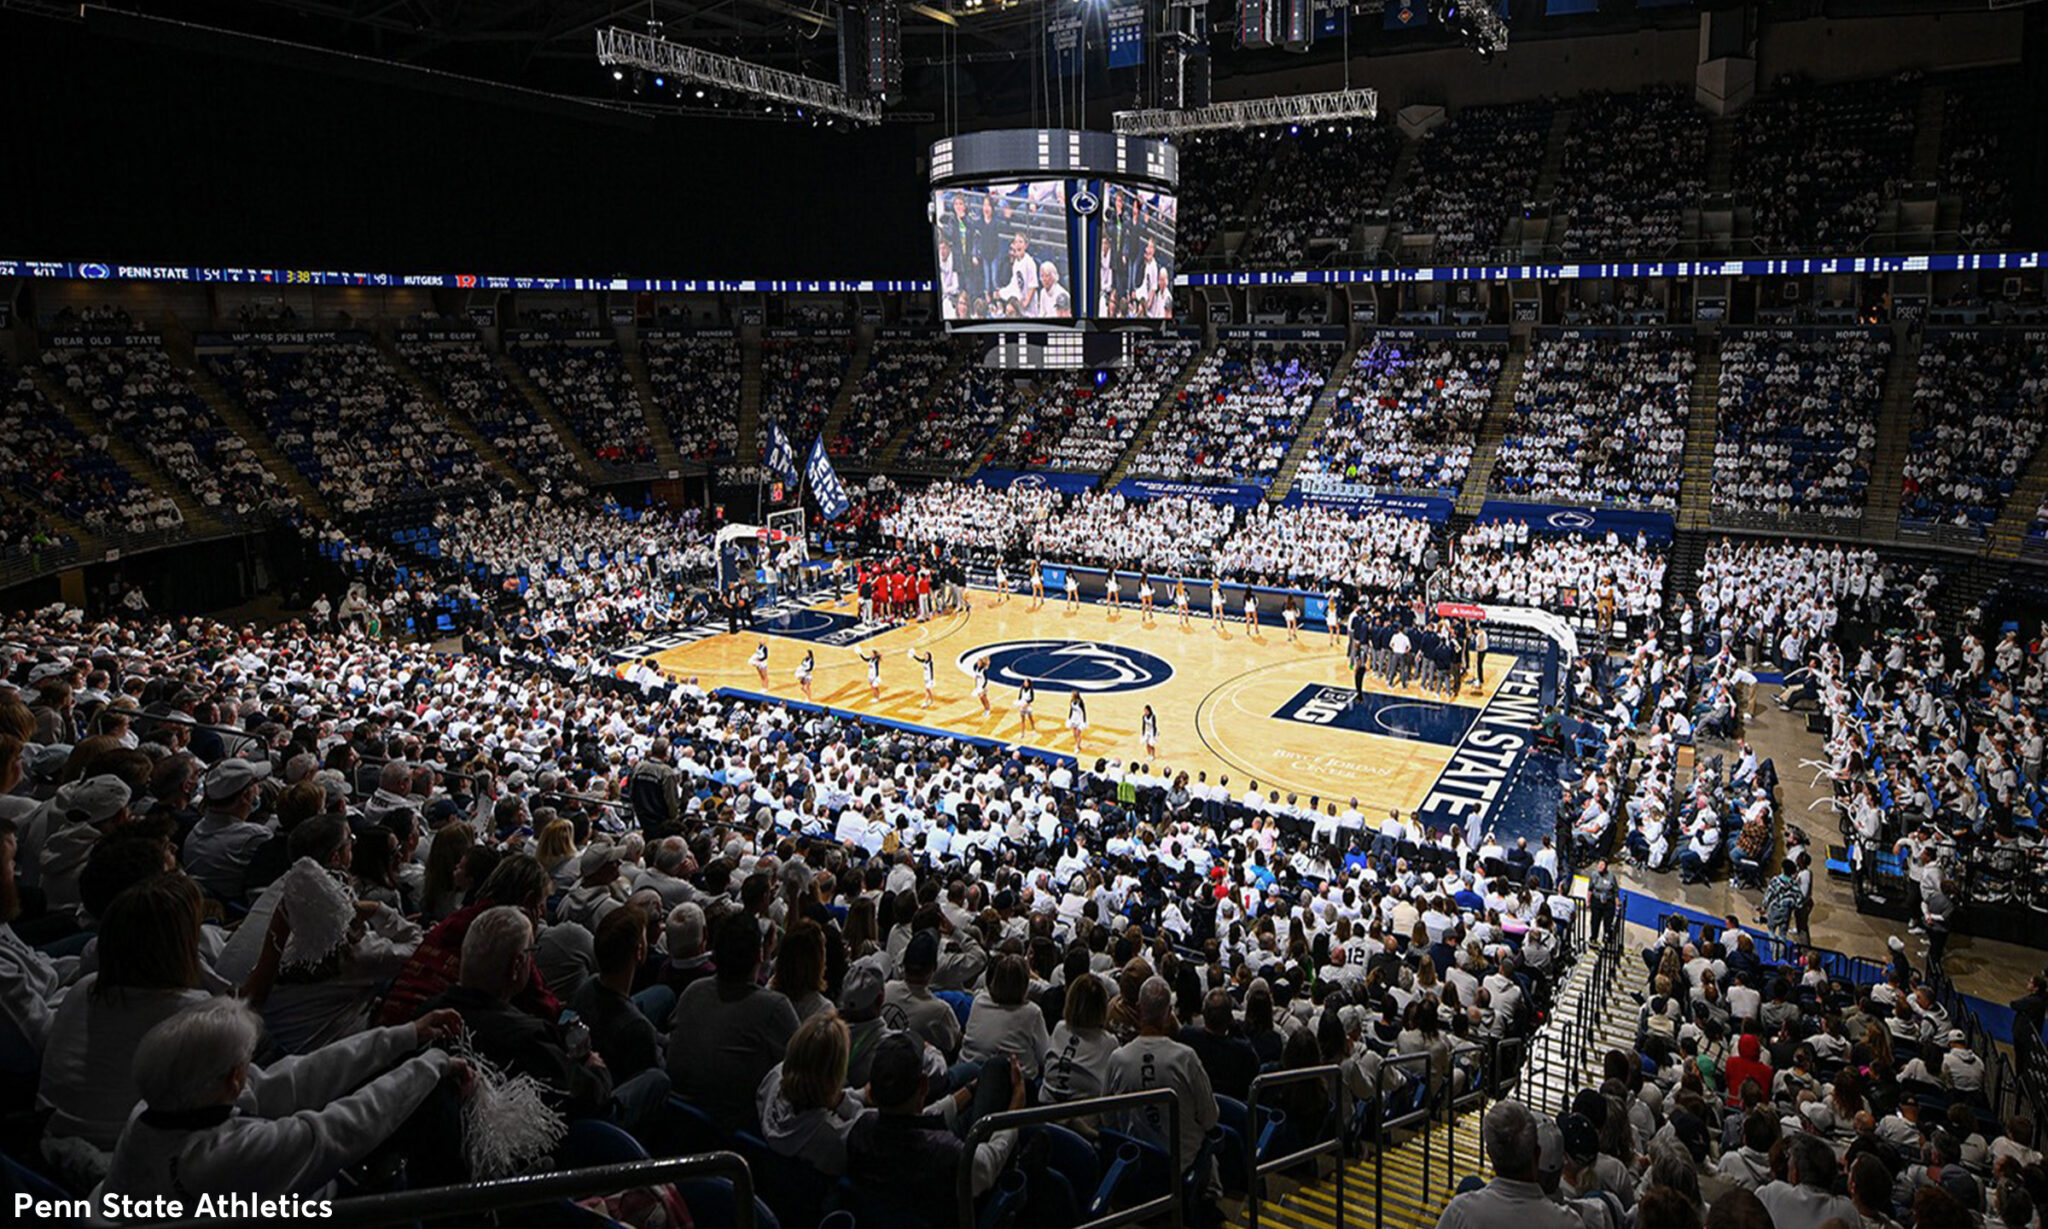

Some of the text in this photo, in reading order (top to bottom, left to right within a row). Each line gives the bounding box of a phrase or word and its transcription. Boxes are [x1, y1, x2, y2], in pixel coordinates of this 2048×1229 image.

[118, 266, 189, 280] PENN STATE
[203, 268, 220, 281] 54
[286, 270, 311, 283] 3:38
[374, 273, 387, 285] 49
[404, 275, 443, 287] RUTGERS
[402, 332, 476, 341] FOR THE GLORY
[534, 332, 549, 340] OLD
[772, 330, 798, 338] STRONG
[1229, 330, 1320, 338] RAISE THE SONG
[1376, 330, 1477, 338] SING OUR LOVE
[1563, 331, 1579, 339] AND
[1743, 330, 1768, 339] SING
[1950, 331, 1978, 340] THAT
[54, 335, 161, 346] DEAR OLD STATE
[1302, 494, 1359, 503] LEGION
[1386, 499, 1428, 509] BLUE
[1273, 748, 1391, 776] BRYCE JORDAN
[1291, 760, 1356, 779] CENTER
[1422, 730, 1525, 820] STATE
[1347, 946, 1365, 966] 12
